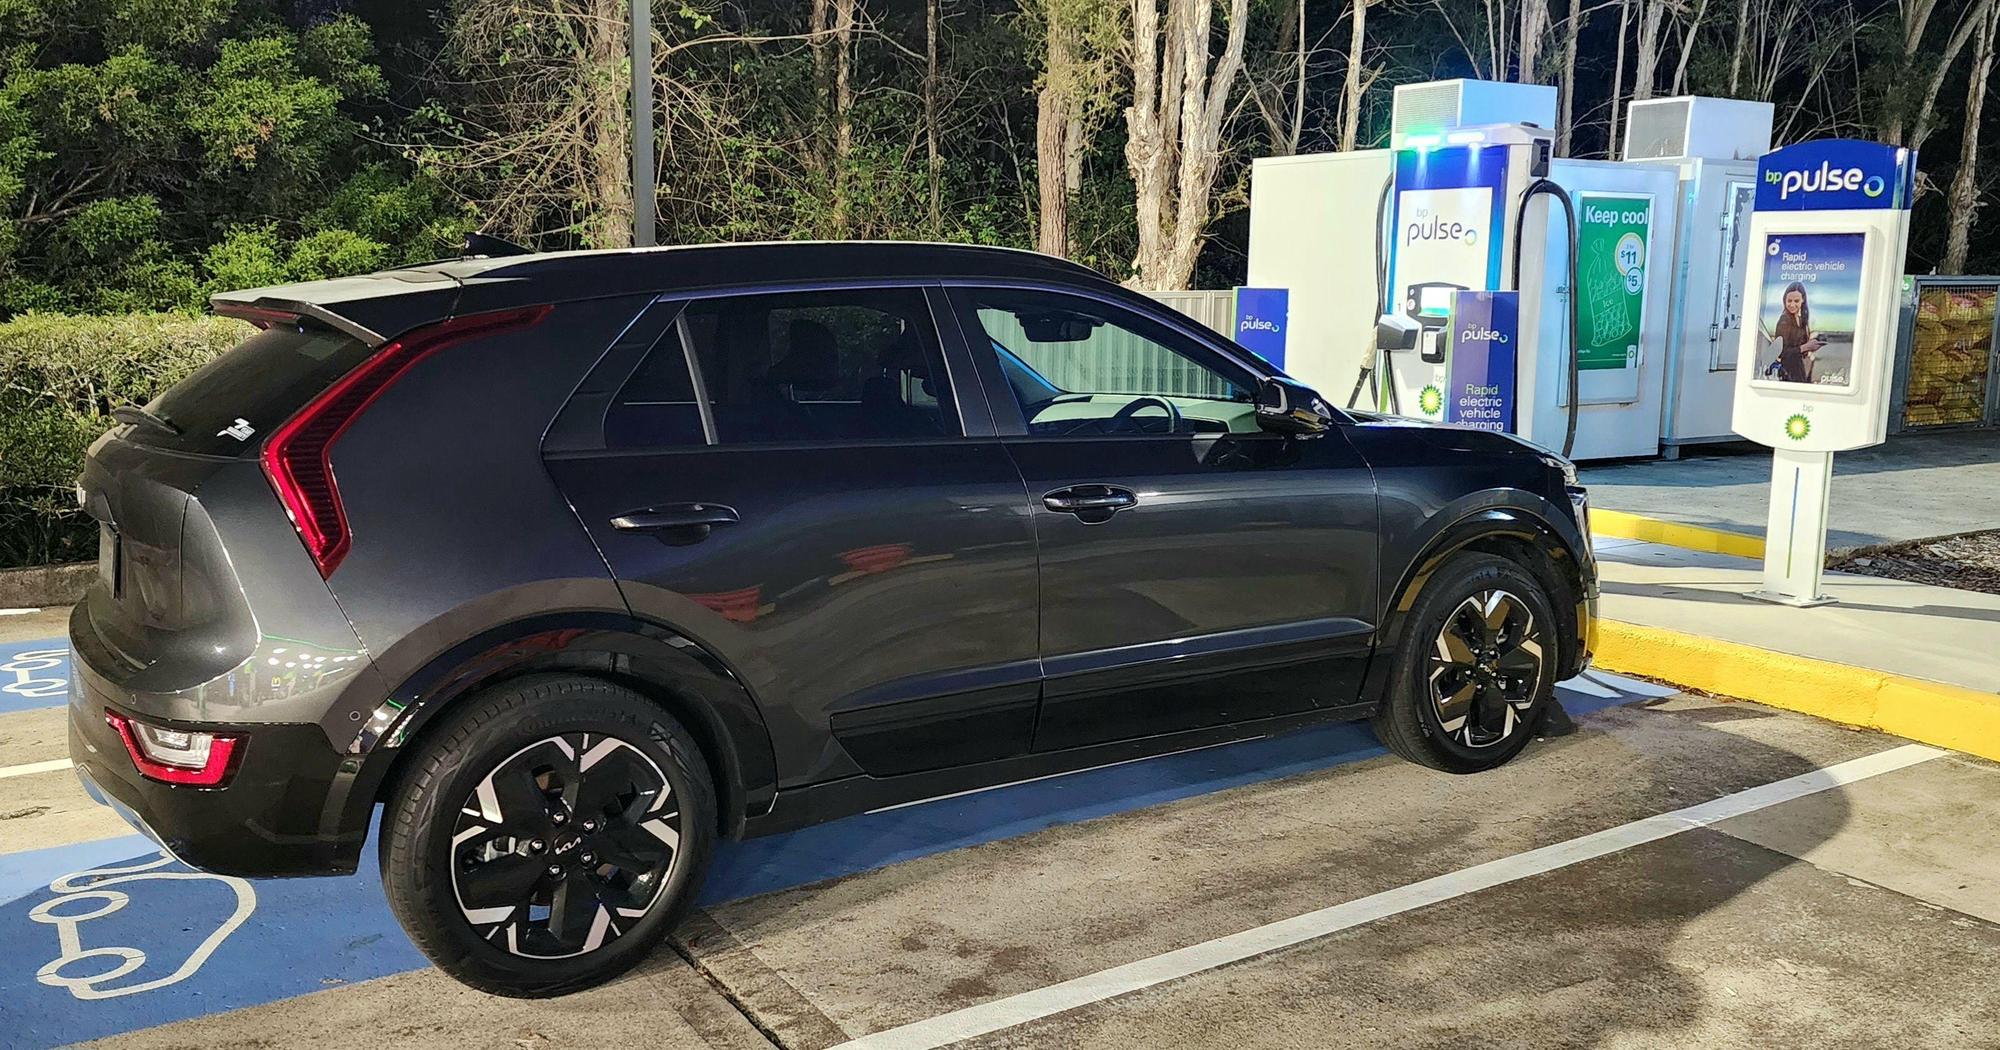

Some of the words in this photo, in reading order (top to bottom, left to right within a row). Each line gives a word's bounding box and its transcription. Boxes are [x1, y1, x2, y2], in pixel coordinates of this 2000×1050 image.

[1765, 169, 1782, 185] bp
[1781, 160, 1863, 200] pulse
[1416, 207, 1429, 219] bp
[1585, 205, 1619, 228] Keep
[1621, 207, 1649, 225] cool
[1407, 214, 1463, 248] pulse
[1620, 250, 1637, 265] $11
[1782, 251, 1807, 263] Rapid
[1781, 262, 1813, 271] electric
[1814, 261, 1845, 271] vehicle
[1628, 275, 1638, 288] $5
[1780, 271, 1817, 283] charging
[1240, 317, 1272, 333] pulse
[1461, 327, 1500, 344] pulse
[1465, 383, 1499, 398] Rapid
[1459, 395, 1503, 408] electric
[1459, 408, 1501, 419] vehicle
